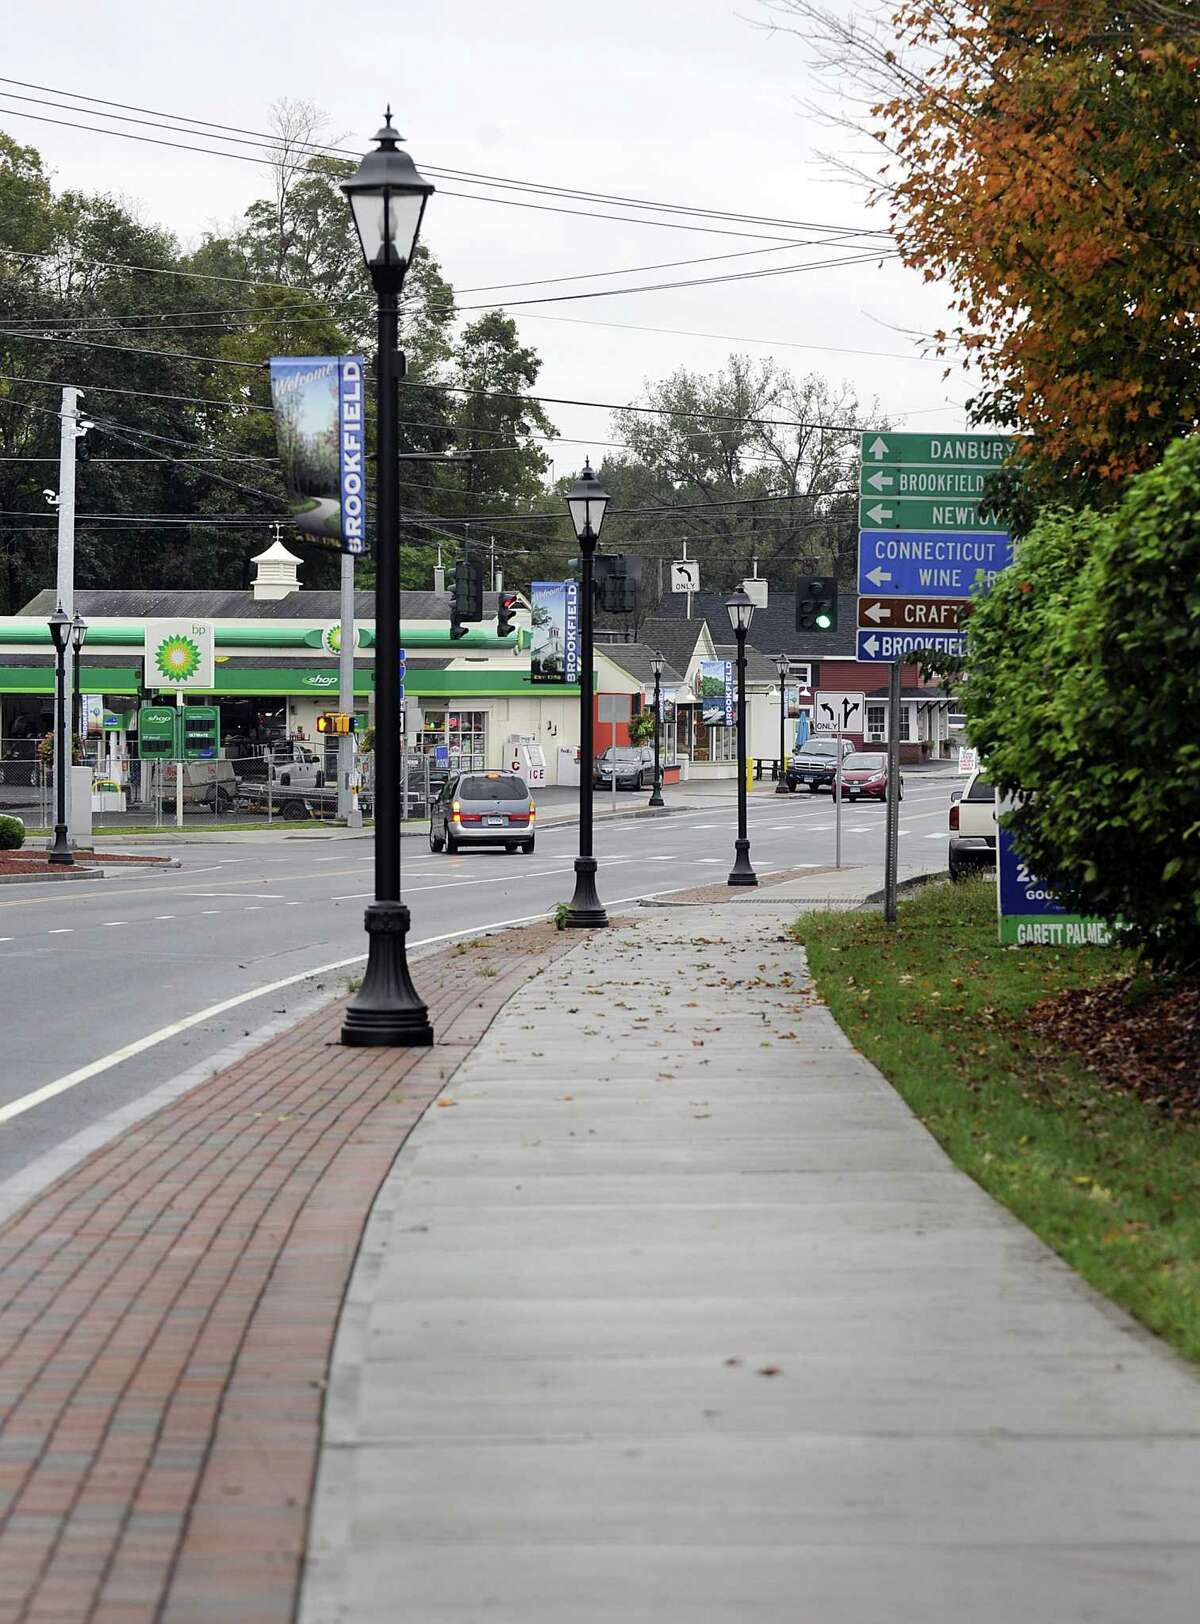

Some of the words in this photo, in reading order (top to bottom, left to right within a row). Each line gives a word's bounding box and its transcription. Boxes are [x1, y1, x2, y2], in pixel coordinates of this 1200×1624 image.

[274, 363, 335, 397] Welcome
[343, 361, 362, 553] BROOKFIELD
[930, 441, 1016, 460] DANBURY
[900, 474, 985, 492] BROOKFIELD
[875, 541, 996, 561] CONNECTICUT
[919, 569, 962, 587] WINE
[192, 624, 207, 636] bp
[566, 585, 578, 682] BROOKFIELD
[882, 637, 970, 657] BROOKFIEL
[307, 674, 338, 686] shop
[725, 661, 733, 726] BROOKFIELD
[148, 714, 172, 724] shop
[816, 722, 838, 730] ONLY
[529, 769, 545, 780] ICE
[1017, 922, 1063, 944] GARETT
